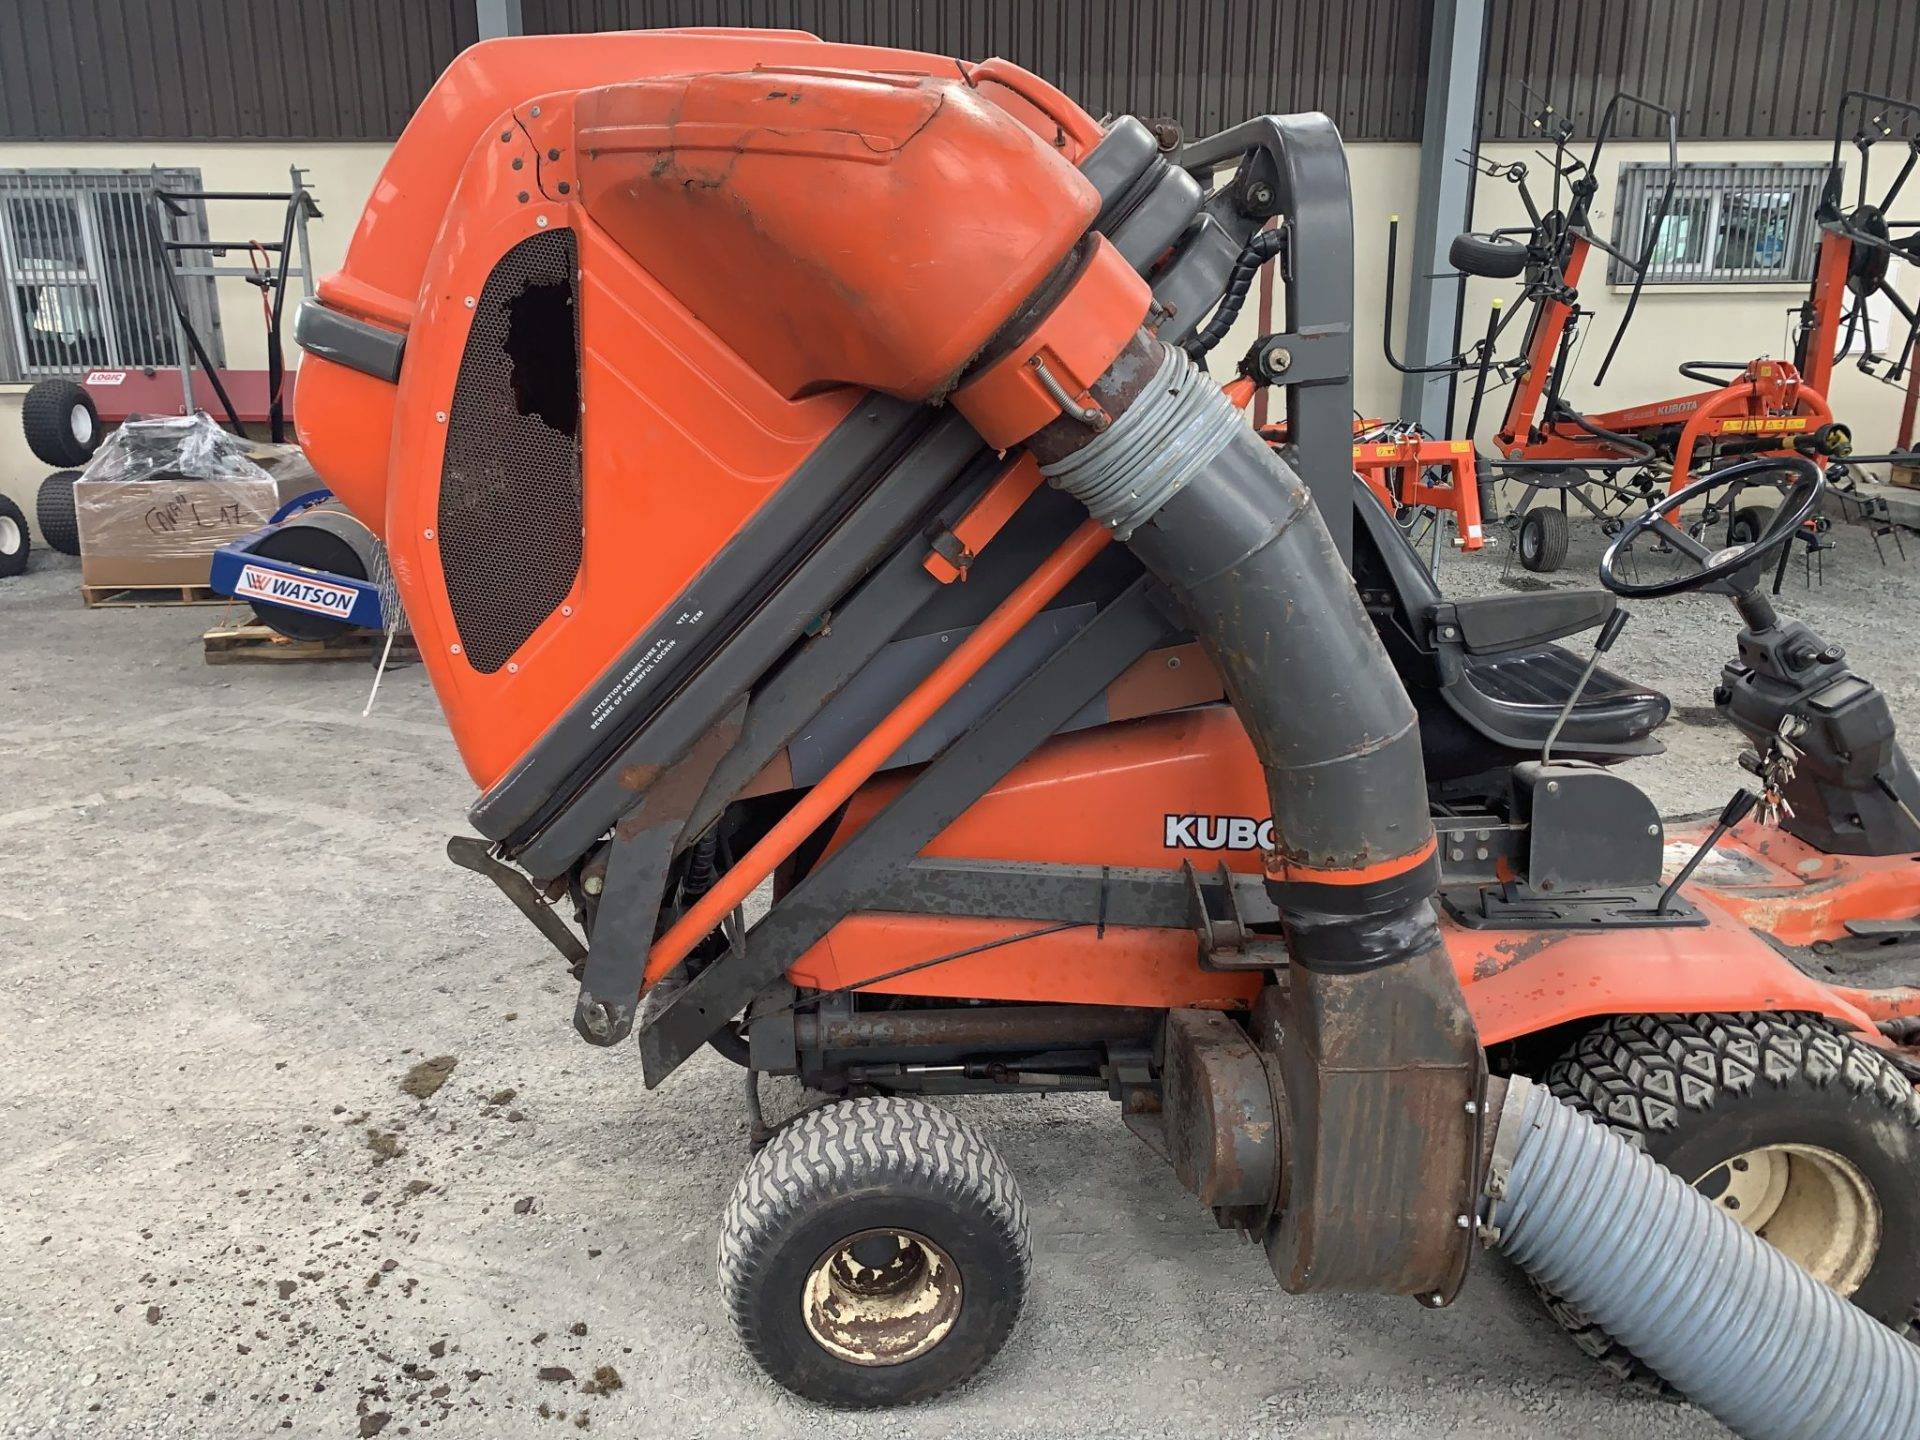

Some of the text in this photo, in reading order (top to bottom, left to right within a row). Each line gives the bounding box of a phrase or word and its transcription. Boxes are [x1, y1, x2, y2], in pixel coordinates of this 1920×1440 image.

[90, 373, 122, 382] LOGIC
[1657, 401, 1698, 416] KUBOTA
[271, 578, 353, 610] WATSON
[590, 704, 615, 730] BEWARE
[613, 695, 623, 705] OF
[622, 664, 654, 696] POWERFUL
[591, 683, 622, 717] ATTENTION
[621, 647, 657, 684] FERMETURE
